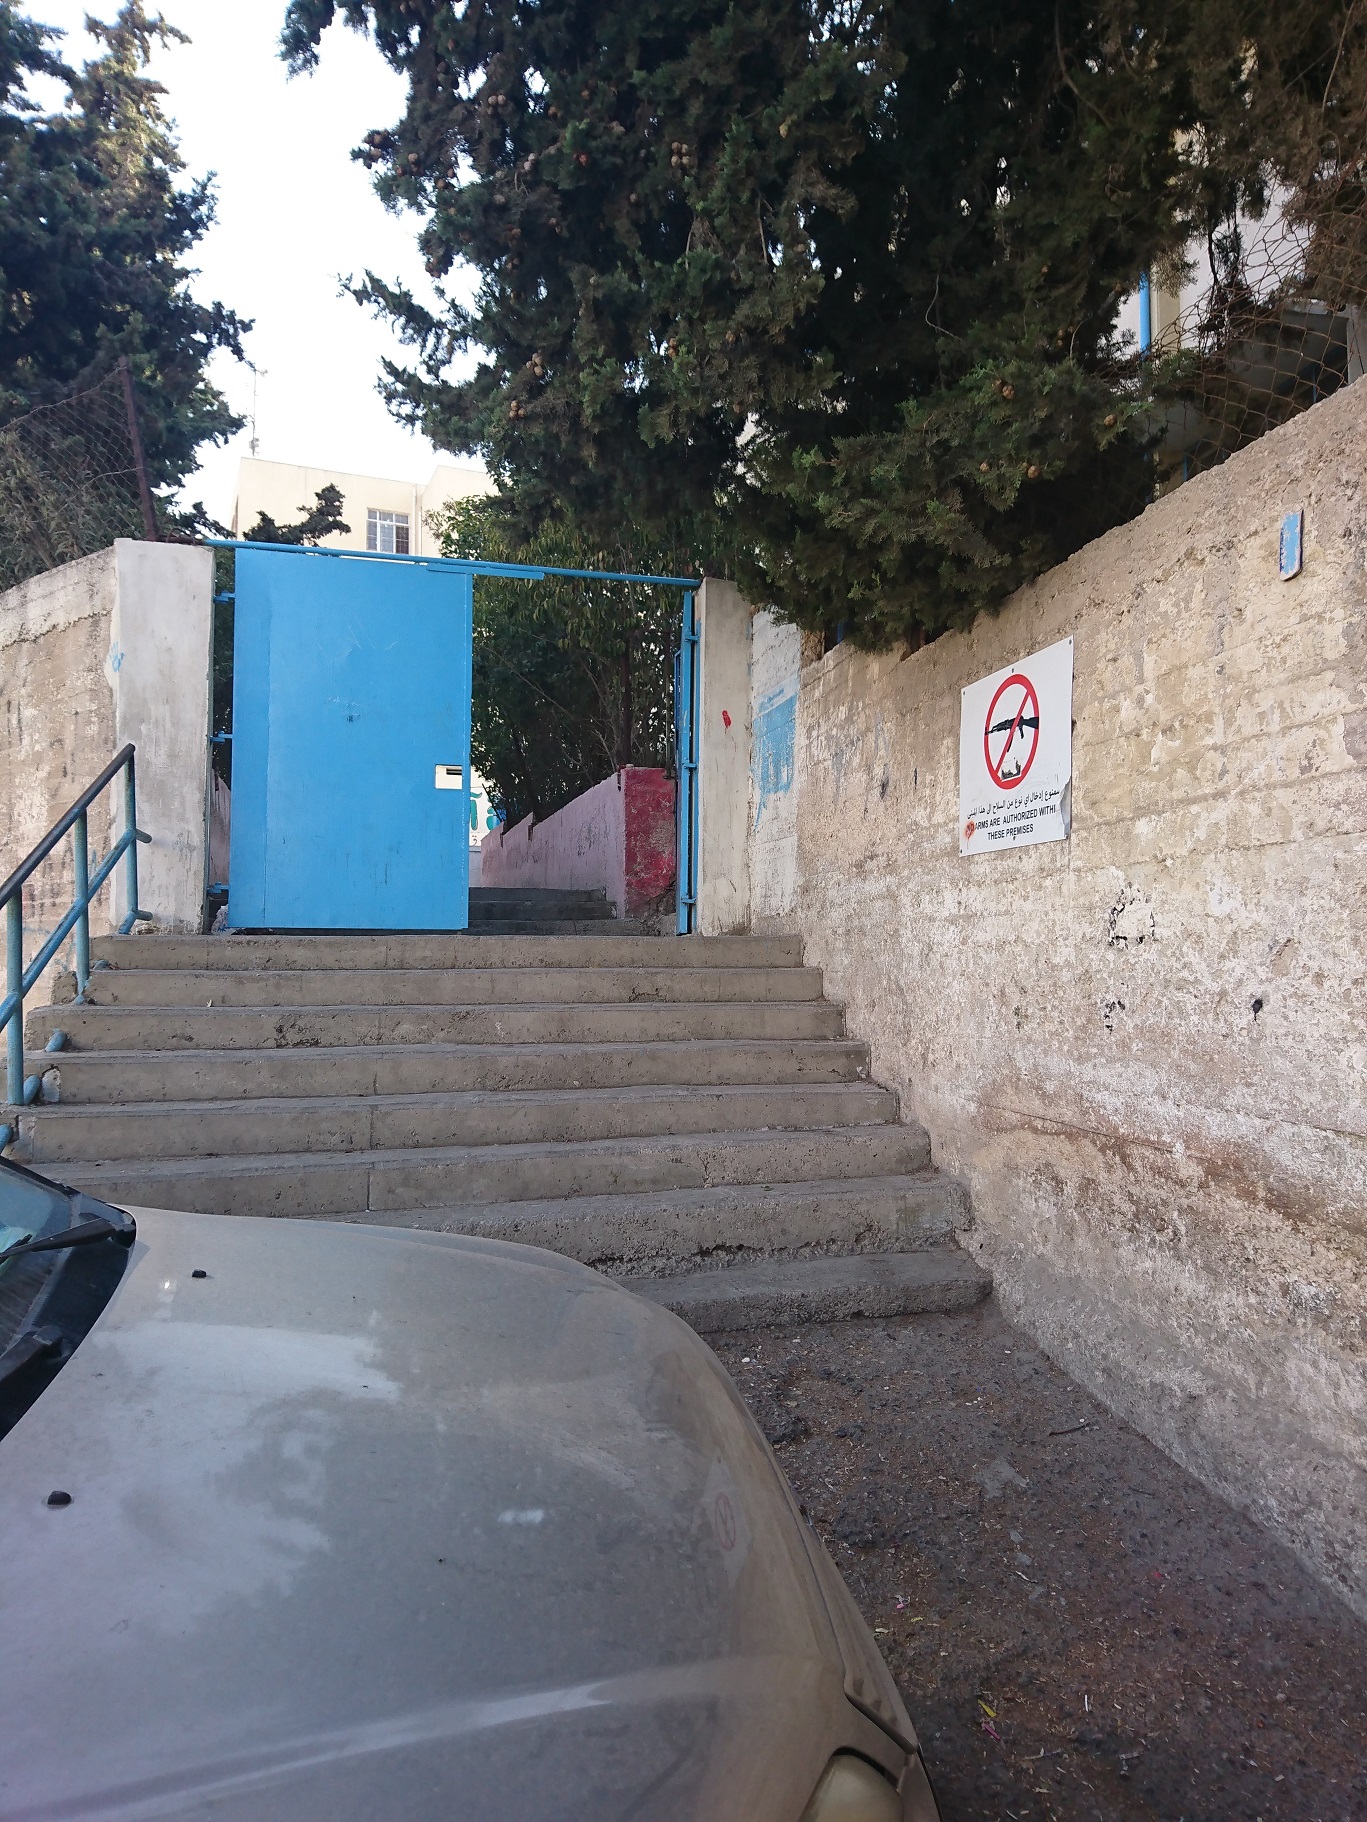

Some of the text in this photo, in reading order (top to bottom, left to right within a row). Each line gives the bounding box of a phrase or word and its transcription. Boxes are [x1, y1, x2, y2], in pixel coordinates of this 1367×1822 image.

[993, 799, 1005, 814] السلاح
[1007, 800, 1013, 809] من
[1014, 796, 1022, 808] نوع
[975, 819, 988, 830] ARMS
[989, 817, 1000, 828] ARE
[1003, 808, 1038, 825] AUTHORIZED
[1039, 804, 1056, 816] WITHI
[987, 823, 1034, 841] THESE PREMISES
